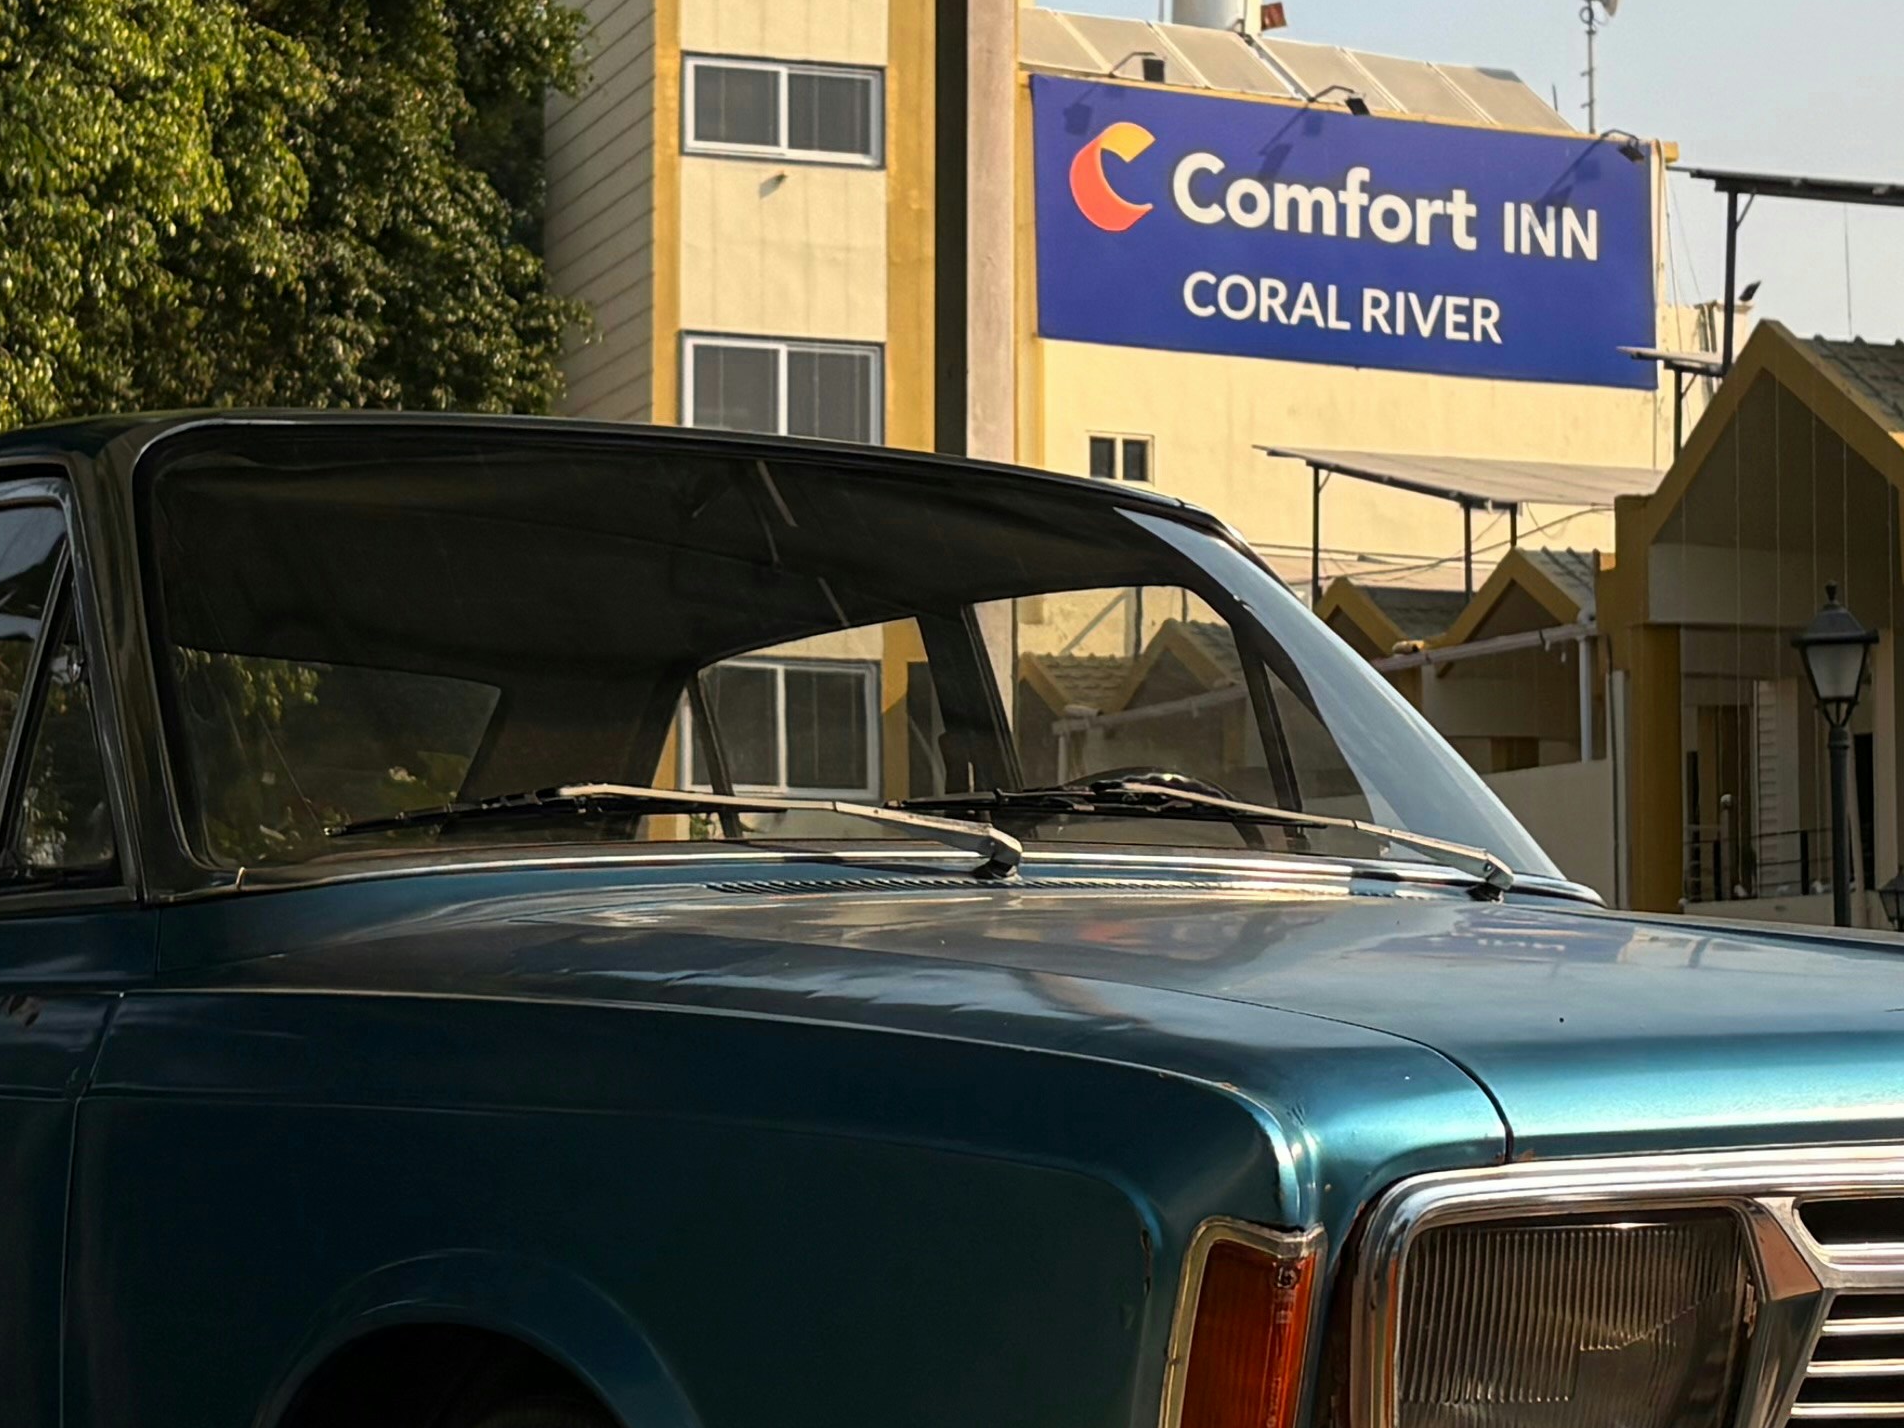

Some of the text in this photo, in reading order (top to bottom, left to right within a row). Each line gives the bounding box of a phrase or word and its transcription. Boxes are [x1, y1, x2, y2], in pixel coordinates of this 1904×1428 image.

[1172, 152, 1598, 262] Comfort INN
[1182, 270, 1502, 344] CORAL RIVER
